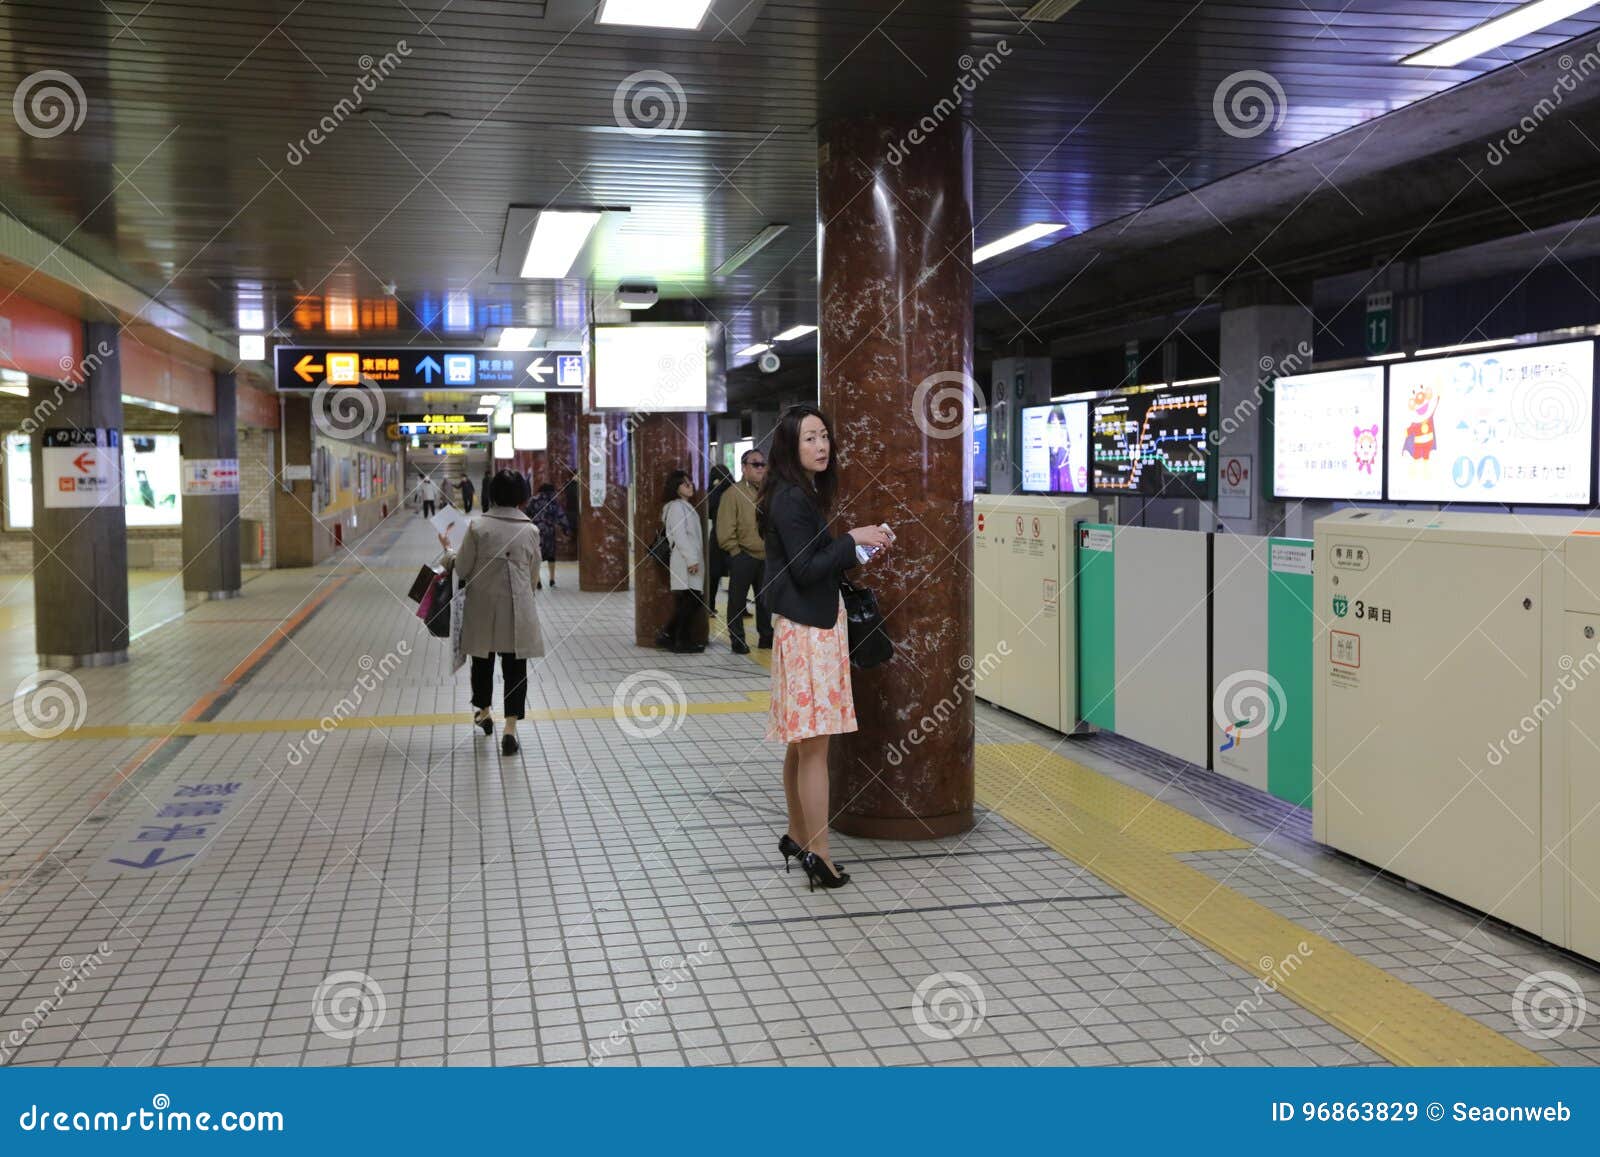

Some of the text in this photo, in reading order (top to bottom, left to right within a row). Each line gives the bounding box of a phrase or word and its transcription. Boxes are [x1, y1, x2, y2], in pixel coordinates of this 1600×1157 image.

[1369, 318, 1387, 345] 11
[1335, 601, 1346, 615] 12
[1355, 600, 1391, 624] 3両目
